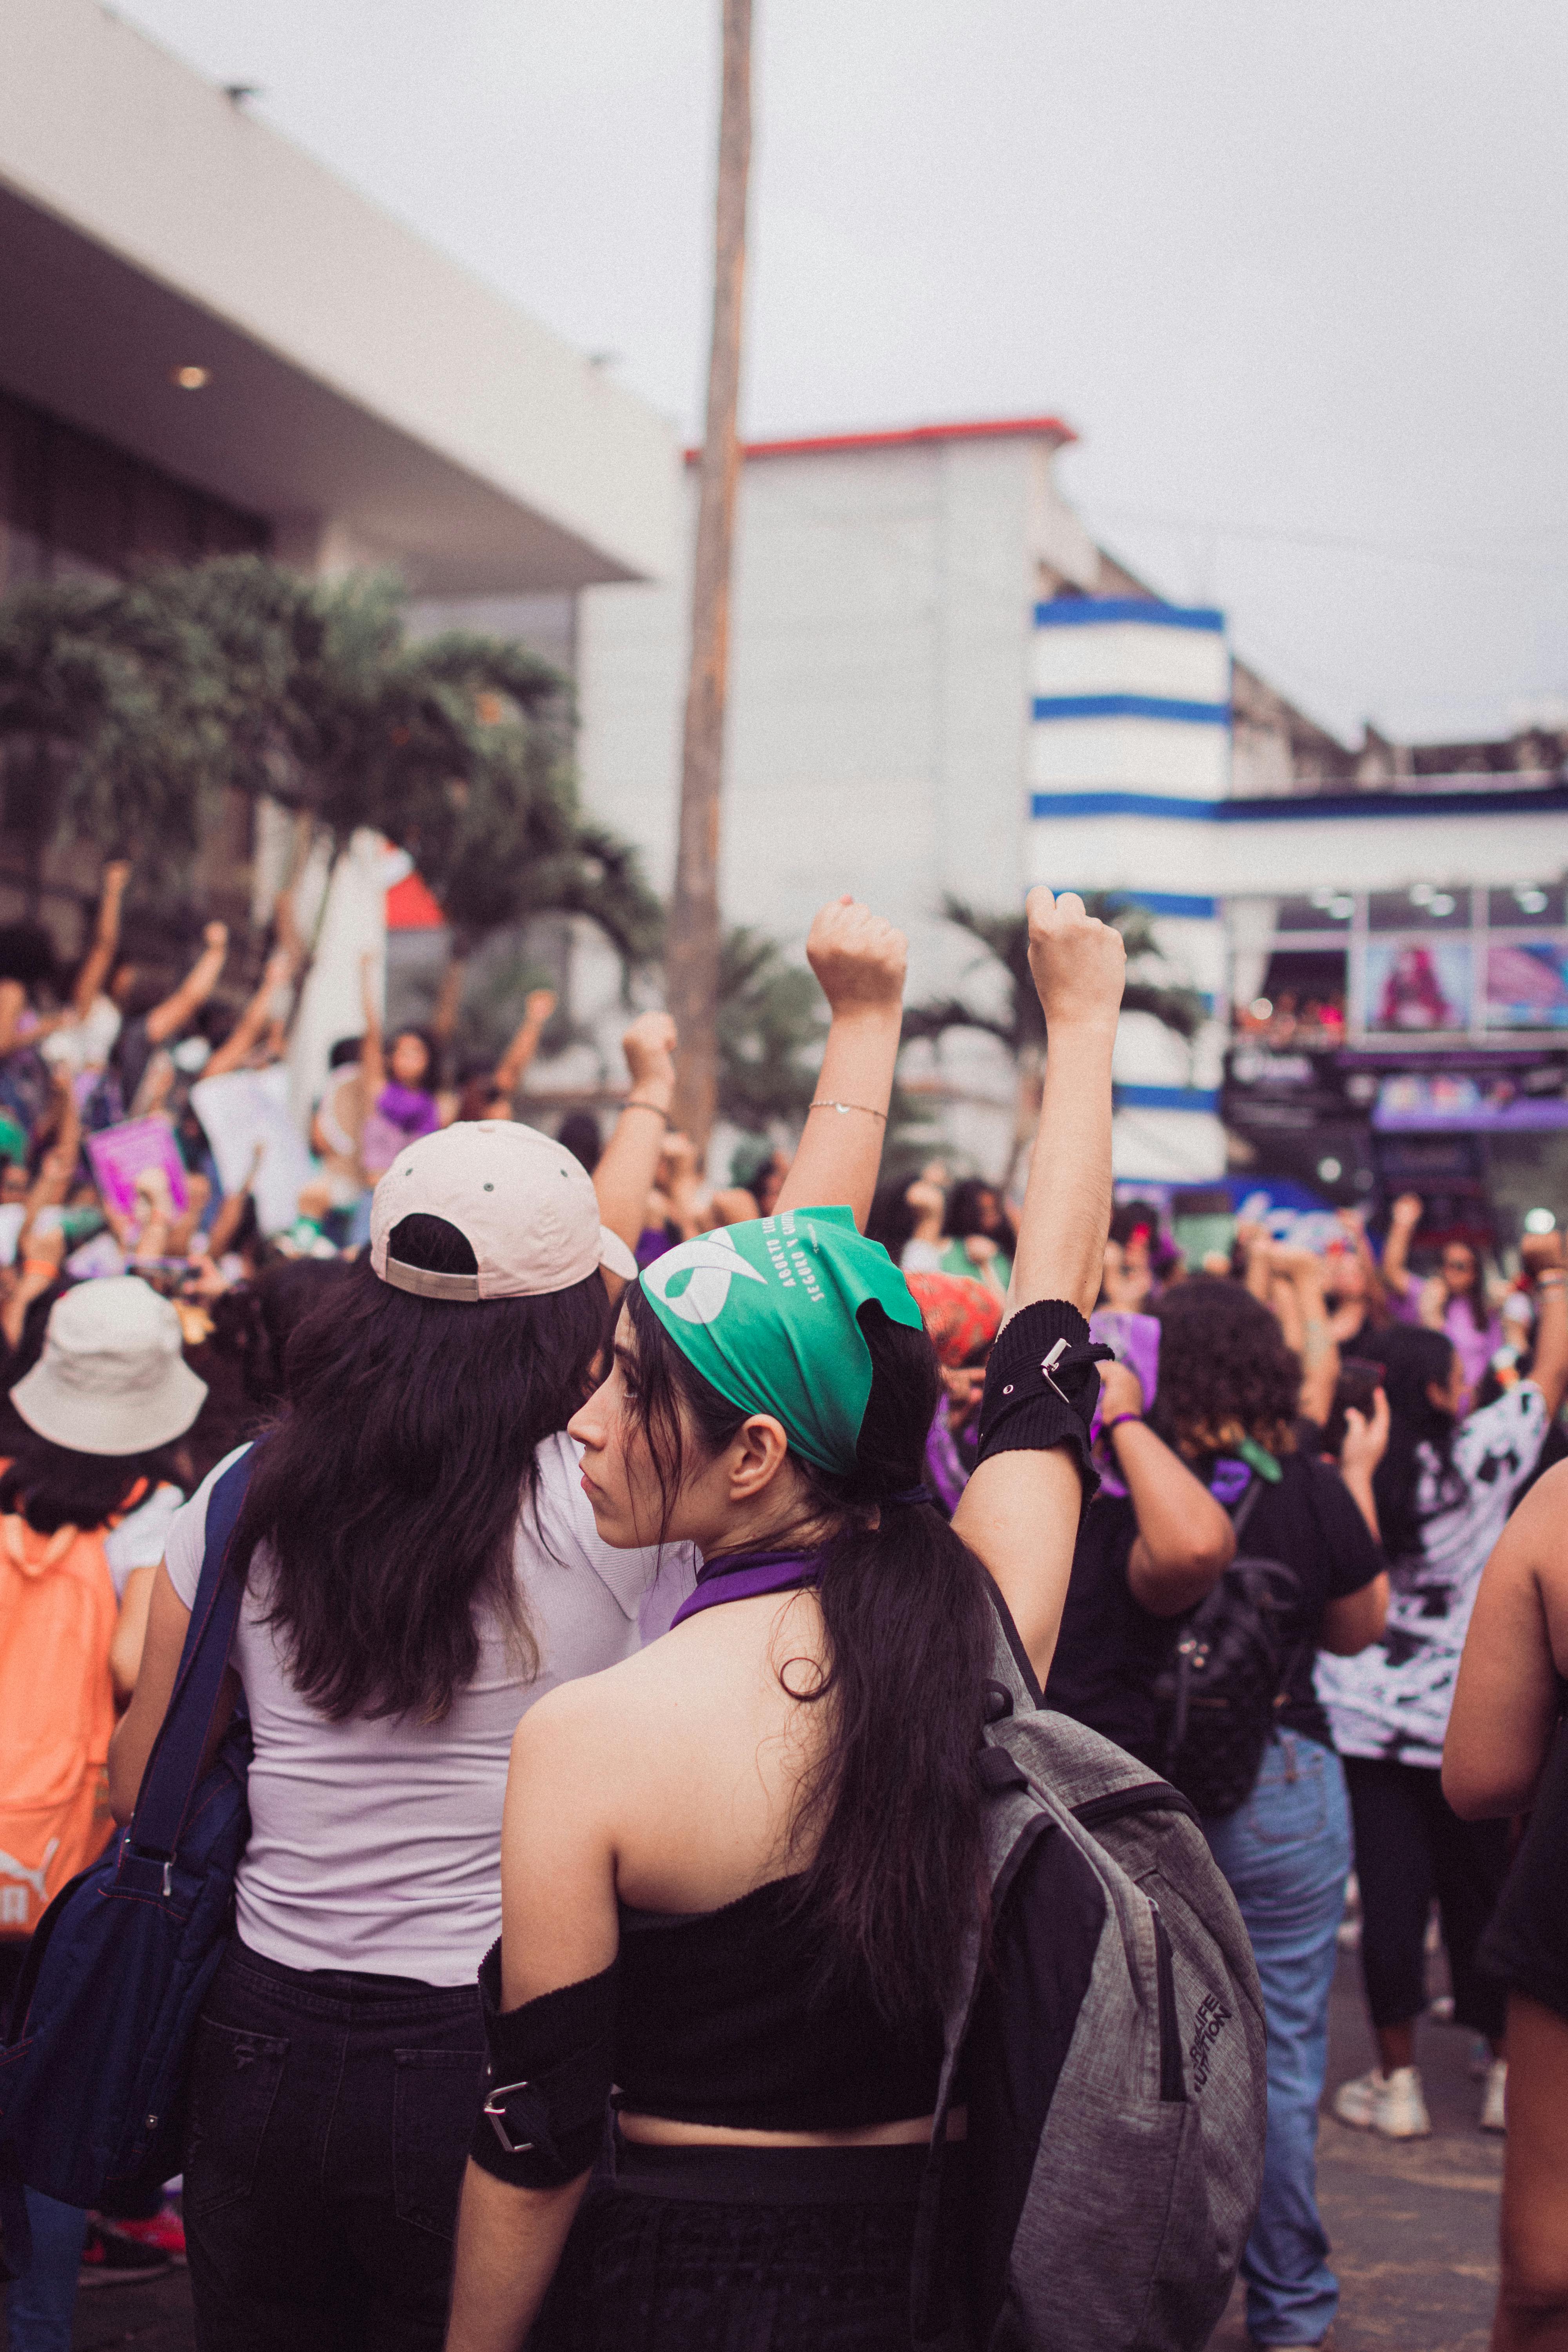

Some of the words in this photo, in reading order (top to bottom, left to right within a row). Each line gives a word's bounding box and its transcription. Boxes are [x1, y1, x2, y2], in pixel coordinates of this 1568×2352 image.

[766, 1239, 796, 1287] ABORTO
[786, 1238, 799, 1248] Y
[791, 1251, 825, 1302] SEGURO
